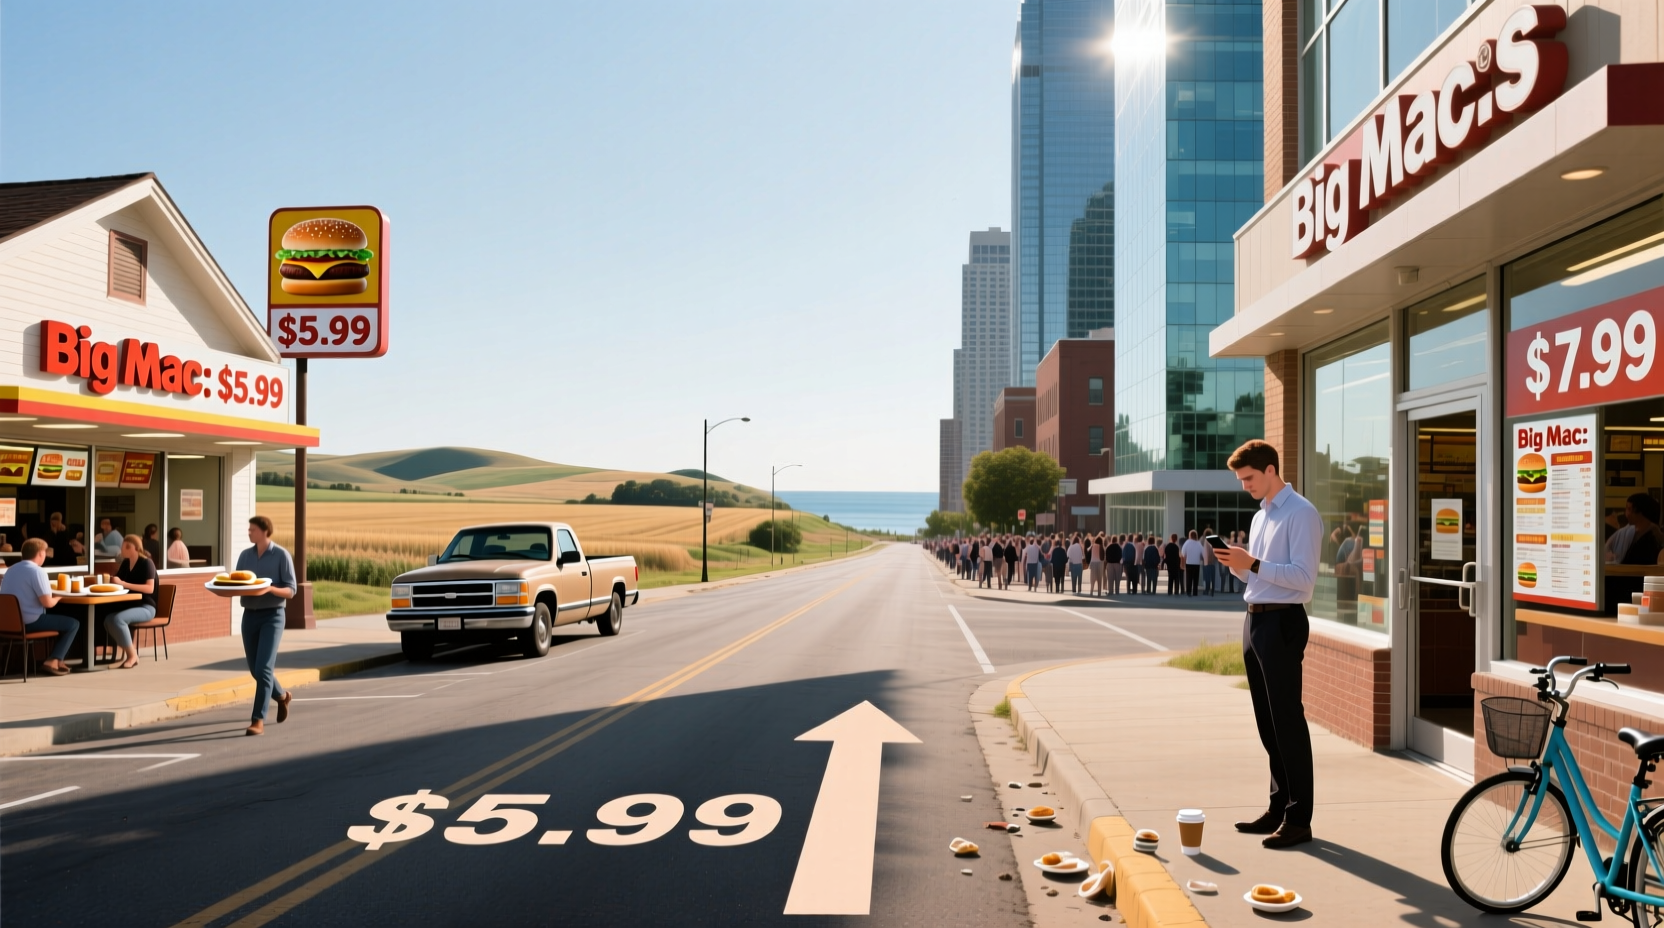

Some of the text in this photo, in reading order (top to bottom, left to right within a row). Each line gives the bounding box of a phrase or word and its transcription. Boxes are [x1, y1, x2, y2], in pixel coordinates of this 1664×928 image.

[1292, 160, 1352, 260] Big
[40, 319, 284, 409] Big Mac: $5.99
[277, 312, 371, 349] $5.99
[1525, 309, 1656, 401] $7.99
[1518, 425, 1588, 452] Big Mac:
[347, 789, 783, 851] $5.99
